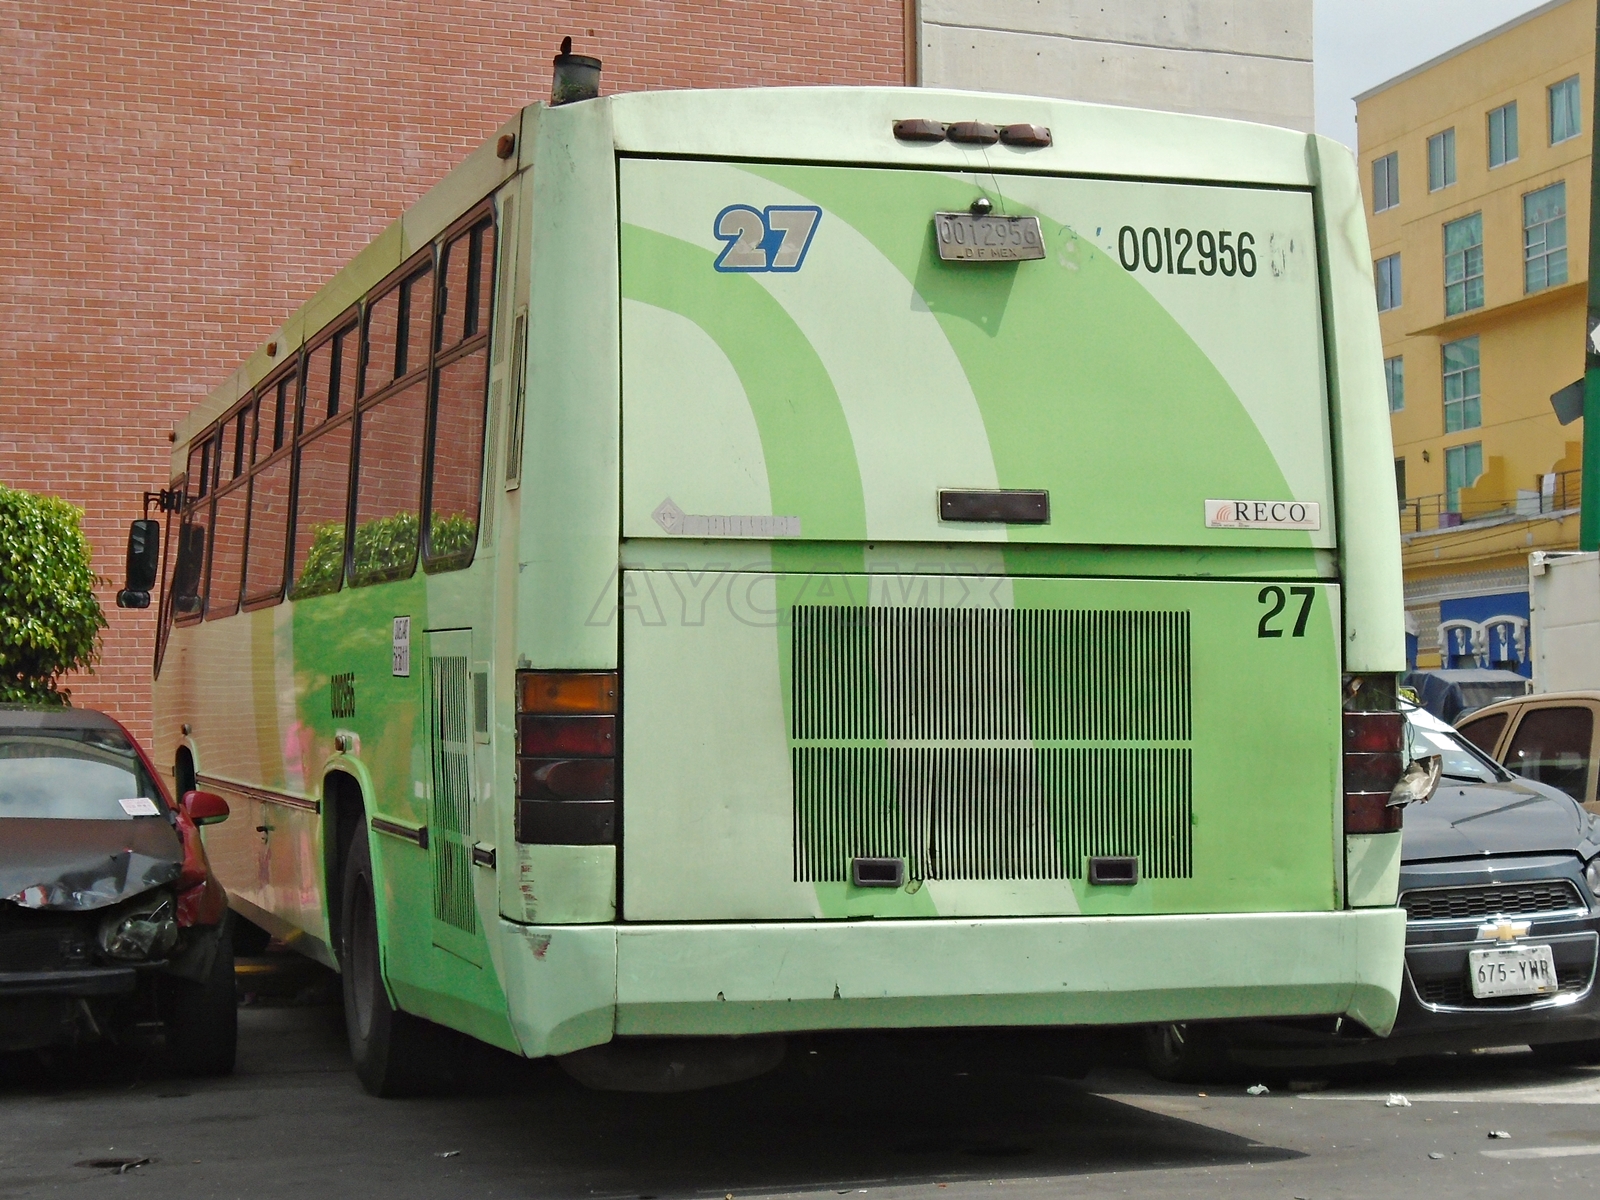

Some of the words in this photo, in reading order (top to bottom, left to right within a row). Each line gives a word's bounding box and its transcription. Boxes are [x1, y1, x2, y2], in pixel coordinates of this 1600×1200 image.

[714, 204, 822, 272] 27
[940, 220, 1036, 246] 0012956
[1118, 225, 1257, 278] 0012956
[1234, 502, 1306, 522] RECO
[1257, 585, 1316, 638] 27
[1478, 960, 1549, 983] 675-YWR
